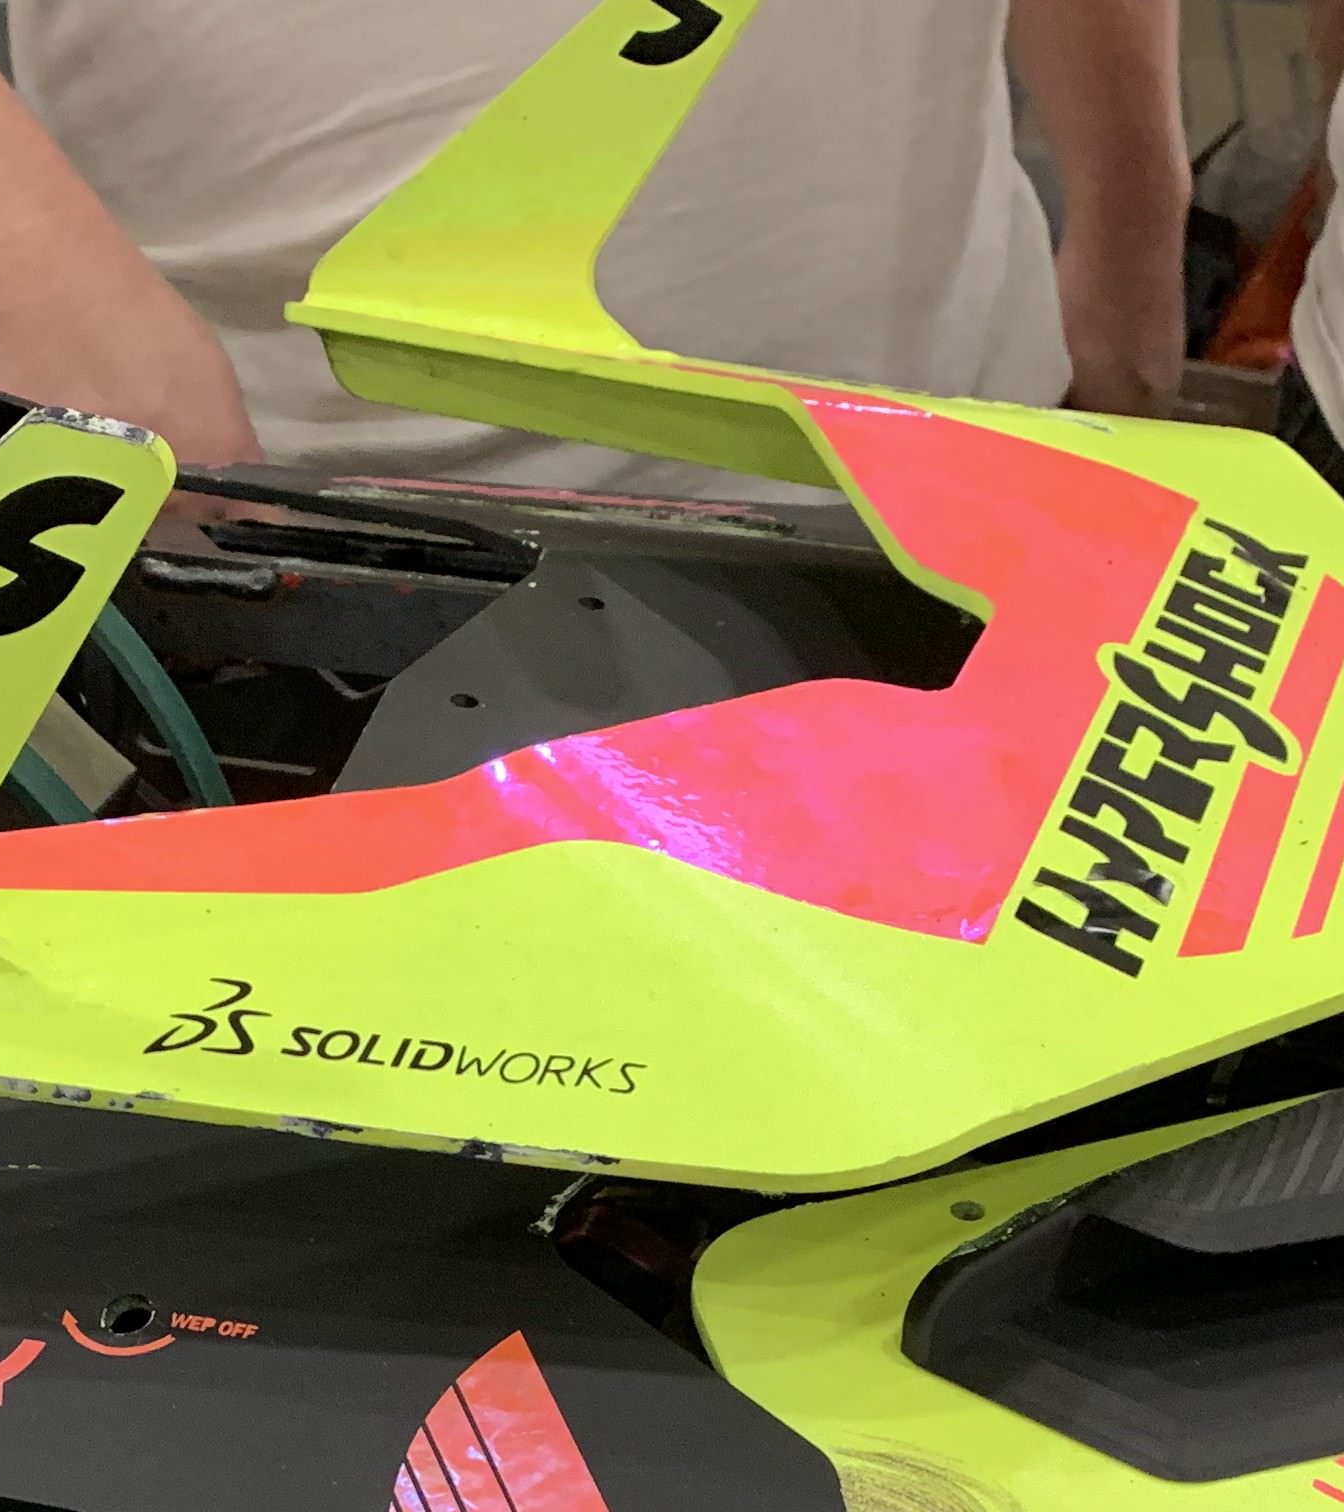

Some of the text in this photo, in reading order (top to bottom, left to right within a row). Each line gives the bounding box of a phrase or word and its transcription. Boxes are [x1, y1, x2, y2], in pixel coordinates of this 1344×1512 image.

[280, 1026, 648, 1095] SOLIDWORKS
[171, 1312, 259, 1339] WEP OFF
